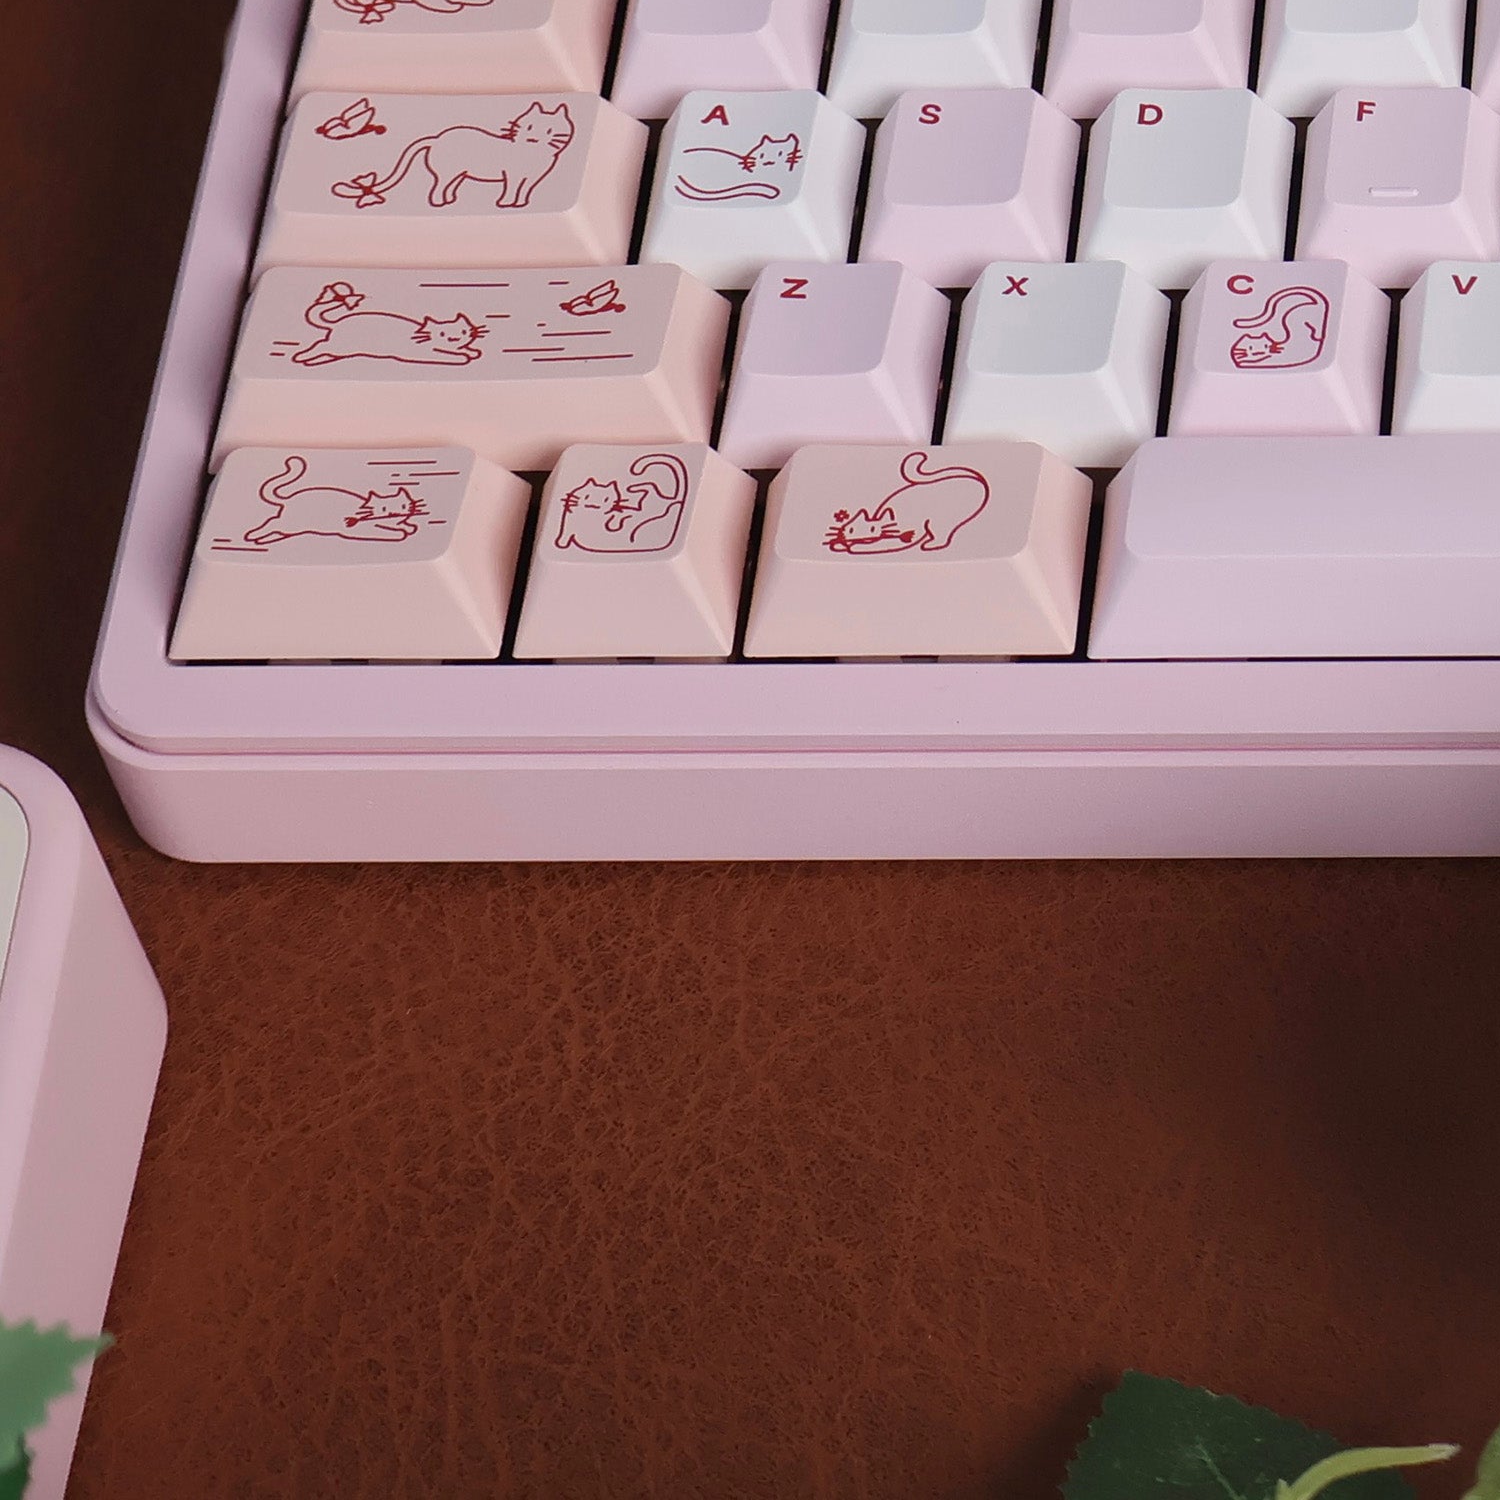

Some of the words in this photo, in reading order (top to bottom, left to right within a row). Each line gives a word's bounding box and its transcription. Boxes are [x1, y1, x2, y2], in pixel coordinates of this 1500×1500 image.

[699, 103, 731, 127] A
[917, 102, 943, 126] S
[1136, 102, 1164, 127] D
[1355, 99, 1377, 123] F
[778, 276, 810, 301] Z
[1001, 274, 1030, 298] X
[1225, 273, 1256, 296] C
[1450, 273, 1479, 296] V
